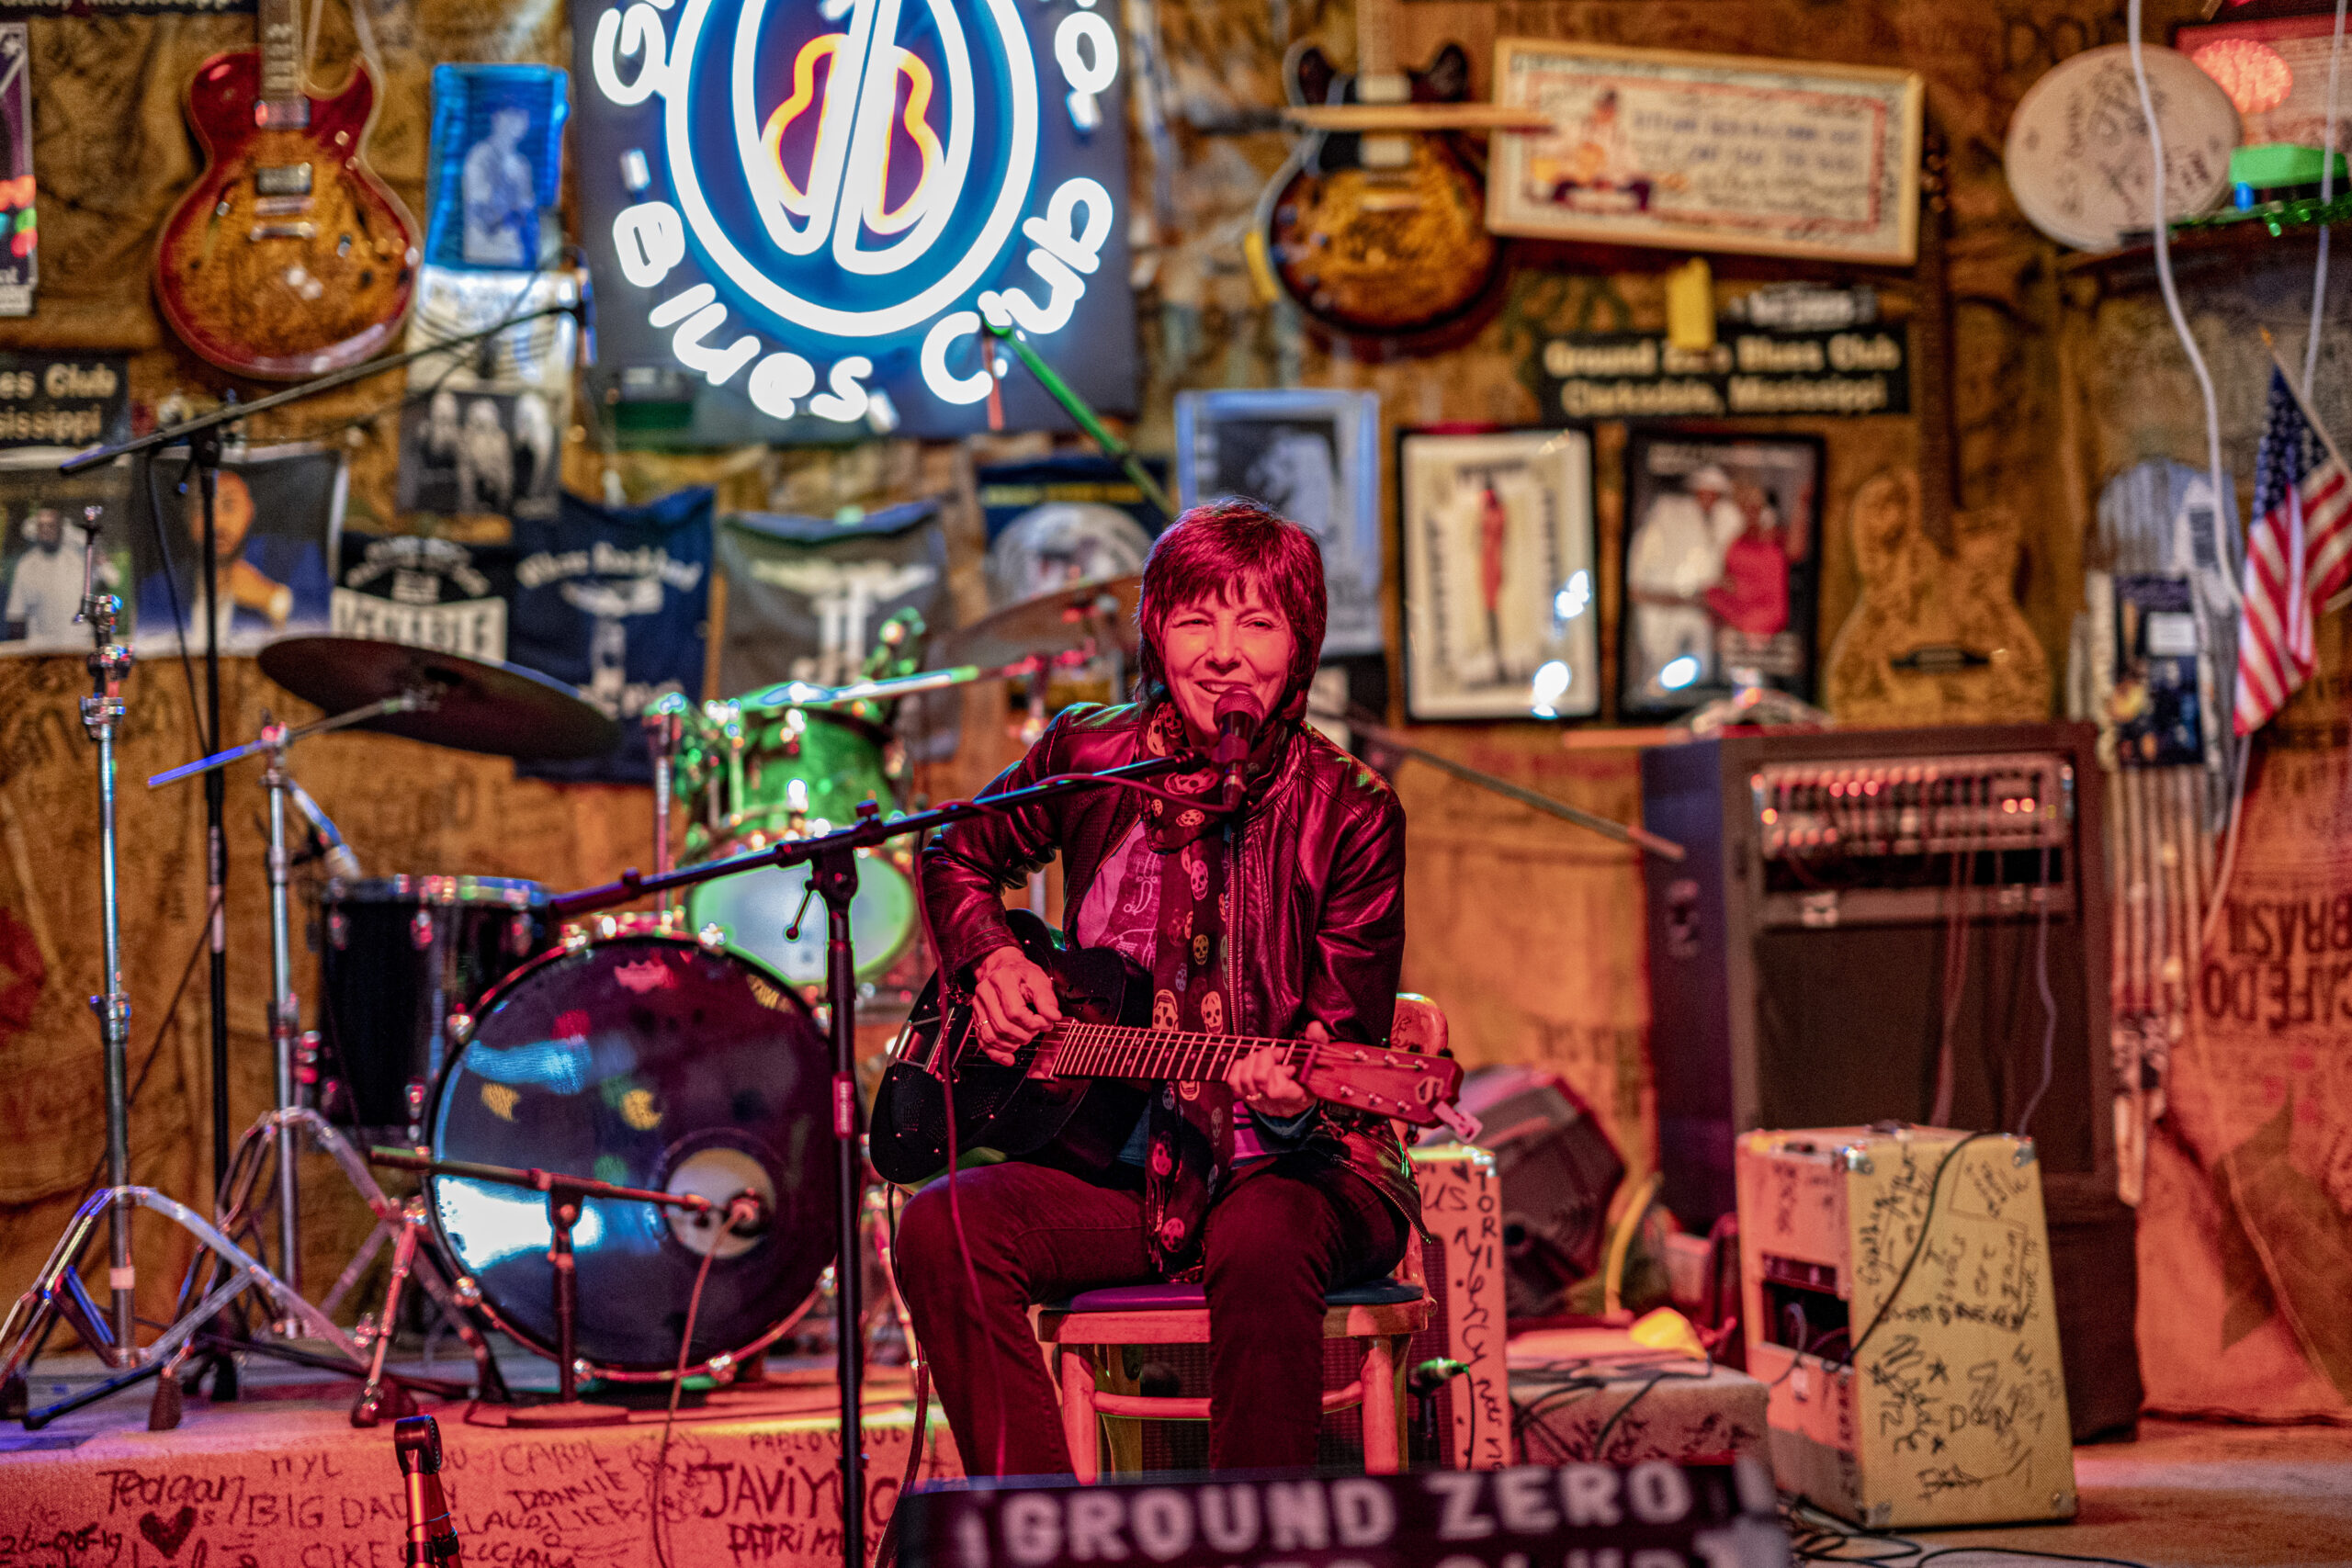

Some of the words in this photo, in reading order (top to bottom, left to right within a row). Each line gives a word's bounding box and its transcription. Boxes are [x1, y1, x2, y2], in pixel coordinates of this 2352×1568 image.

[921, 177, 1114, 405] Club
[1827, 333, 1901, 371] Club
[44, 362, 118, 399] Club
[246, 1494, 325, 1529] BIG
[1000, 1476, 1397, 1565] GROUND
[1423, 1461, 1694, 1541] ZERO
